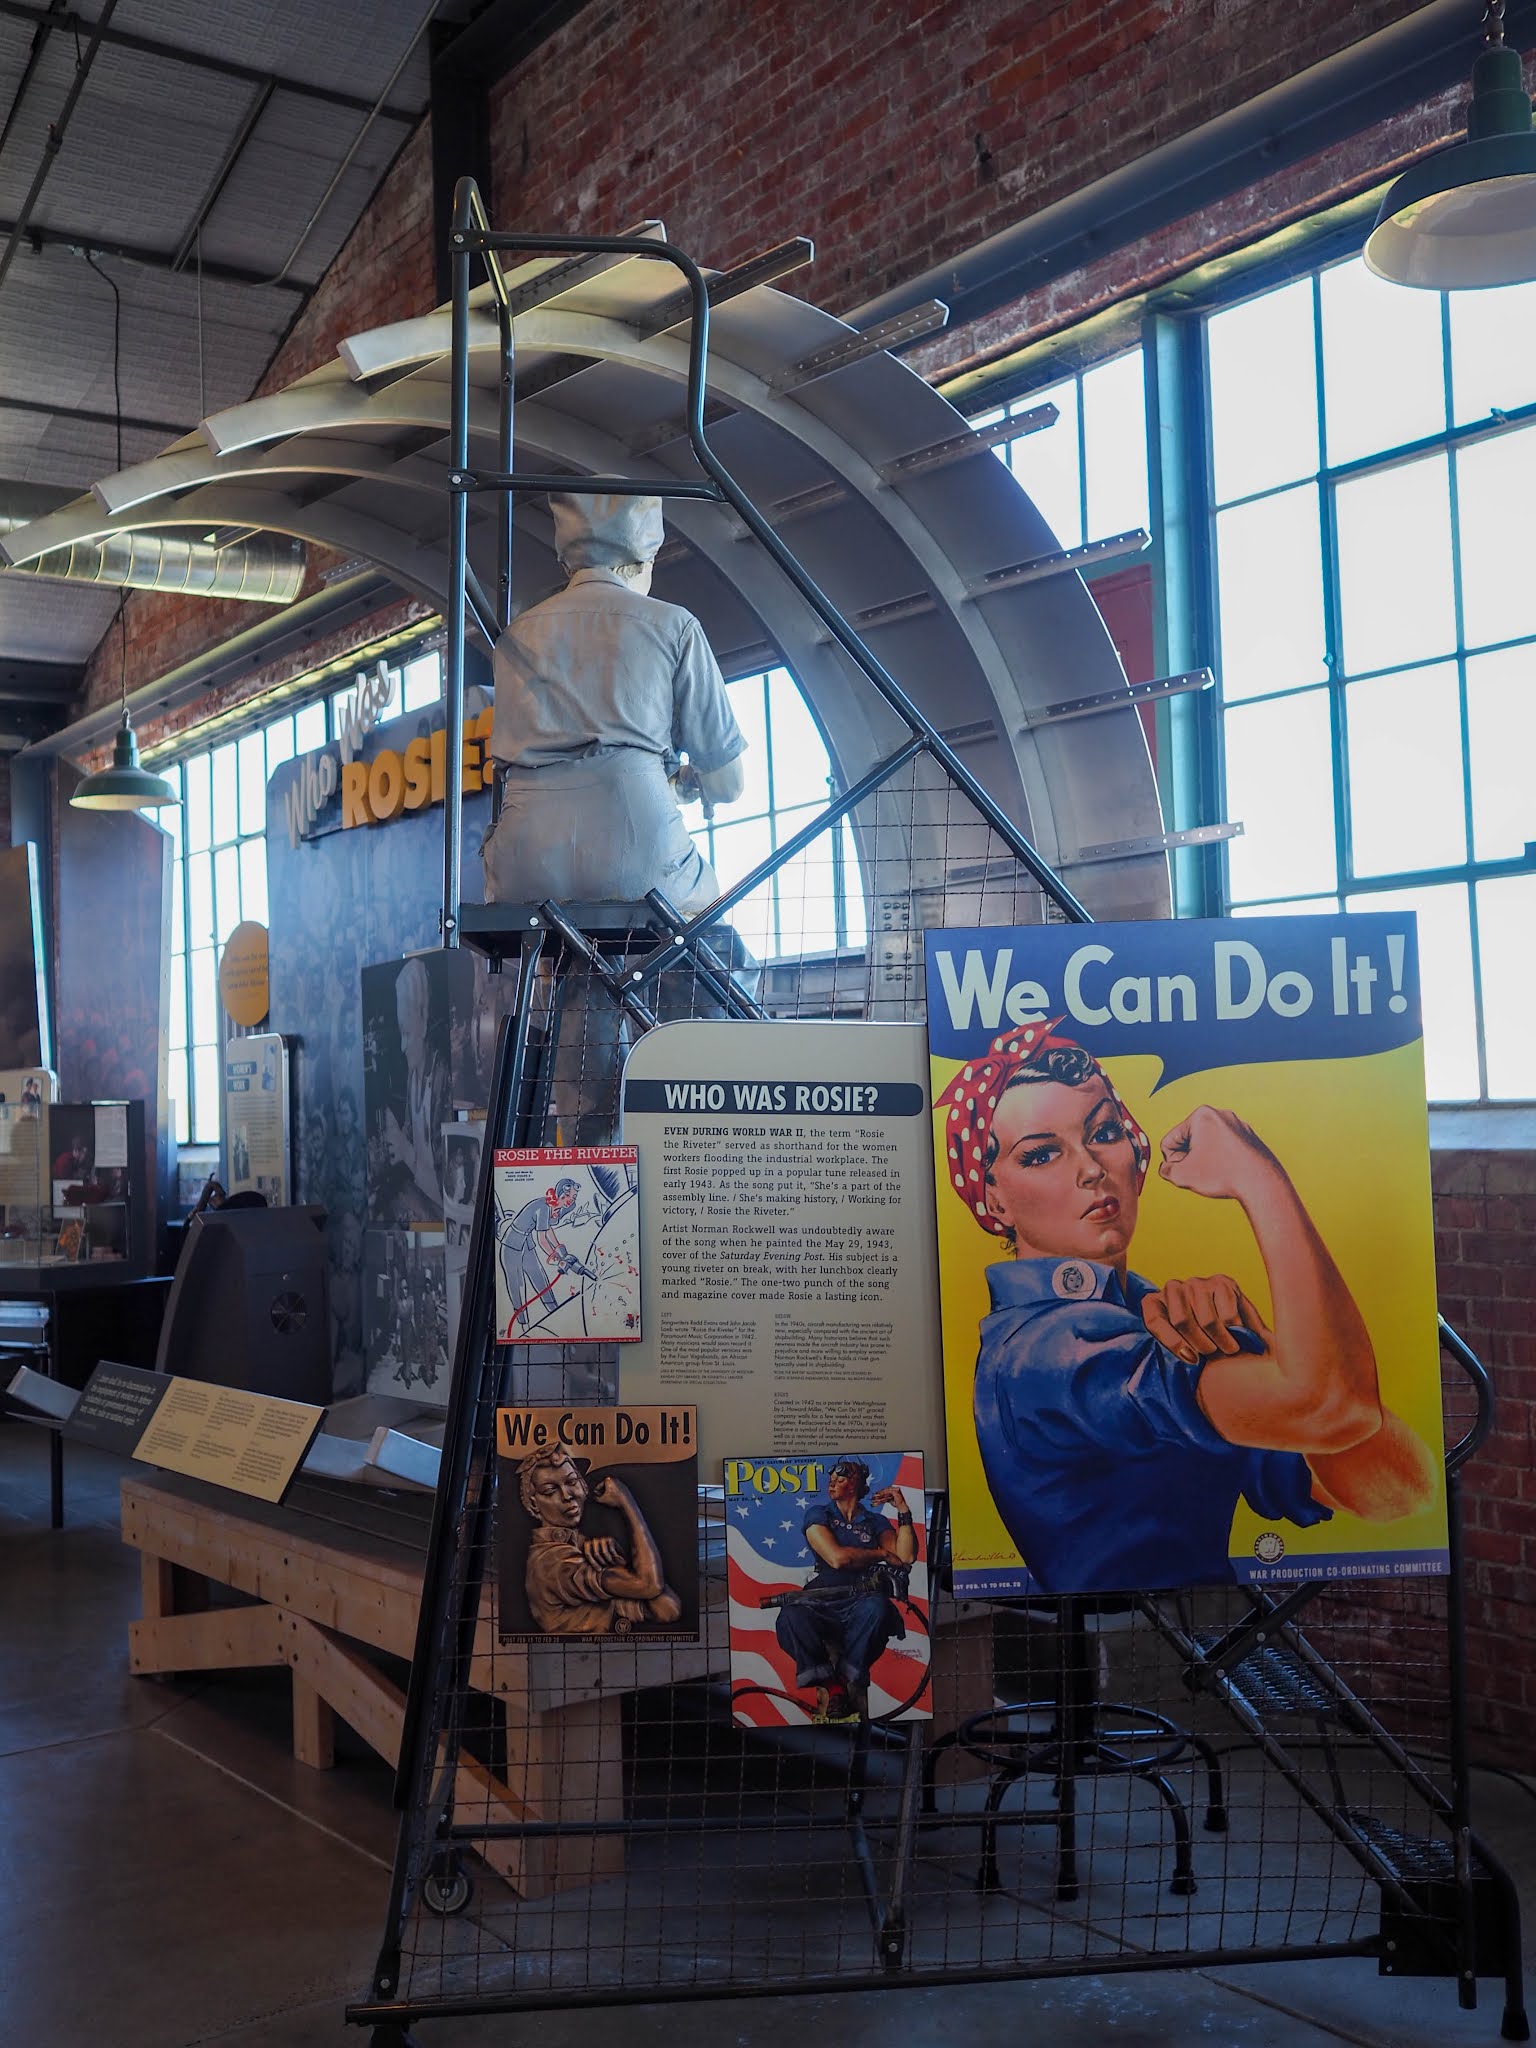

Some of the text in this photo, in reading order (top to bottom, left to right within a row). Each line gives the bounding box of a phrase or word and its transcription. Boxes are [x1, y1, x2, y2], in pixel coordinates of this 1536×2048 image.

[284, 659, 395, 849] Who Was
[935, 934, 1408, 1030] We Can Do It!
[664, 1083, 878, 1112] WHO WAS ROSIE?
[664, 1126, 688, 1135] EVEN
[692, 1127, 728, 1135] DURING
[732, 1127, 765, 1136] WORLD
[769, 1128, 792, 1136] WAR
[795, 1128, 805, 1138] II,
[810, 1128, 825, 1137] the
[855, 1129, 884, 1137] "Rosie
[663, 1139, 679, 1148] the
[682, 1140, 721, 1148] Riveter"
[725, 1141, 756, 1149] served
[773, 1141, 823, 1150] shorthand
[826, 1141, 839, 1150] for
[843, 1142, 858, 1150] the
[497, 1147, 637, 1161] ROSIE THE RIVETER
[663, 1153, 888, 1165] workers flooding the industrial workplace. The
[663, 1166, 681, 1174] first
[684, 1166, 708, 1175] Rosie
[711, 1167, 746, 1177] popped
[749, 1169, 761, 1177] up
[764, 1167, 773, 1175] in
[786, 1168, 822, 1178] popular
[849, 1168, 887, 1177] released
[890, 1169, 900, 1177] in
[663, 1179, 686, 1189] early
[690, 1179, 715, 1188] 1943.
[719, 1180, 730, 1188] As
[733, 1180, 749, 1188] the
[752, 1182, 774, 1191] song
[777, 1181, 793, 1191] put
[796, 1180, 805, 1190] it,
[810, 1181, 838, 1189] "She's
[850, 1183, 870, 1191] part
[873, 1182, 882, 1190] of
[885, 1182, 900, 1190] the
[662, 1192, 706, 1203] assembly
[708, 1193, 729, 1201] line.
[739, 1193, 762, 1202] She's
[766, 1194, 800, 1204] making
[803, 1194, 837, 1204] history,
[847, 1194, 885, 1205] Working
[889, 1195, 901, 1203] for
[662, 1205, 696, 1216] victory,
[707, 1206, 731, 1214] Rosie
[735, 1206, 750, 1215] the
[753, 1206, 794, 1215] Riveter."
[661, 1224, 688, 1232] Artist
[691, 1224, 728, 1233] Norman
[732, 1225, 775, 1233] Rockwell
[801, 1226, 862, 1236] undoubtedly
[662, 1237, 892, 1249] of the song when he painted the May 29, 1943,
[689, 1250, 698, 1259] of
[701, 1251, 716, 1259] the
[719, 1251, 760, 1261] Saturday
[763, 1251, 801, 1262] Evening
[803, 1252, 824, 1260] Post.
[828, 1252, 842, 1261] His
[845, 1252, 878, 1263] subject
[881, 1253, 889, 1261] is
[661, 1265, 690, 1274] young
[693, 1264, 724, 1272] riveter
[742, 1264, 771, 1274] break,
[775, 1265, 797, 1273] with
[801, 1265, 816, 1273] her
[819, 1265, 863, 1274] lunchbox
[867, 1266, 897, 1276] clearly
[661, 1276, 696, 1285] marked
[700, 1277, 737, 1285] "Rosie."
[740, 1277, 757, 1286] The
[803, 1279, 833, 1288] punch
[836, 1278, 846, 1287] of
[849, 1279, 864, 1287] the
[867, 1281, 889, 1289] song
[661, 1290, 679, 1298] and
[683, 1291, 727, 1300] magazine
[759, 1291, 784, 1299] made
[788, 1291, 812, 1300] Rosie
[825, 1292, 856, 1302] lasting
[860, 1292, 882, 1301] icon.
[504, 1412, 690, 1446] We Can Do It!
[726, 1461, 824, 1496] POST
[1250, 1562, 1442, 1580] WAR PRODUCTION CO-ORDINATING COMMITTEE
